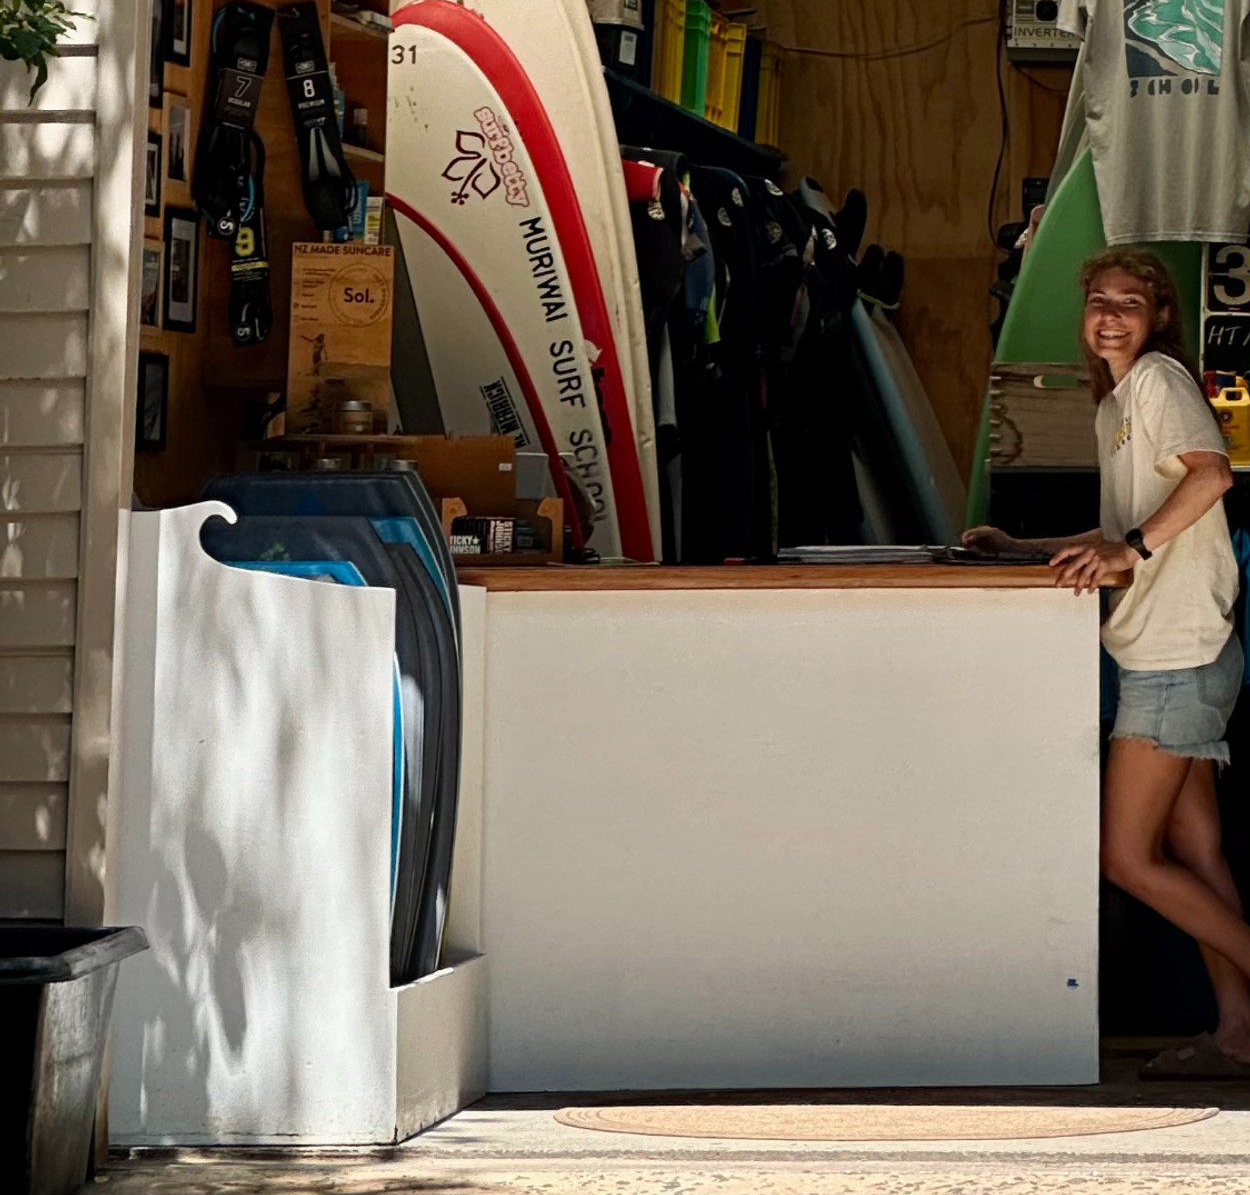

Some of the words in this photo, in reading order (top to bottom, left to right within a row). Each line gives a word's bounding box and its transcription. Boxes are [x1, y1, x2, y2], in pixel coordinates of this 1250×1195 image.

[391, 44, 417, 65] 31
[234, 75, 252, 98] 7
[303, 79, 316, 98] 8
[473, 105, 531, 208] surfbetty
[235, 226, 255, 257] 8
[294, 244, 309, 253] NZ
[310, 245, 341, 255] MADE
[342, 246, 392, 257] SUNCARE
[344, 287, 375, 304] Sol.
[519, 216, 569, 324] MURIWAI
[550, 340, 587, 409] SURF
[1207, 324, 1241, 346] HT
[483, 379, 522, 435] MERRICK
